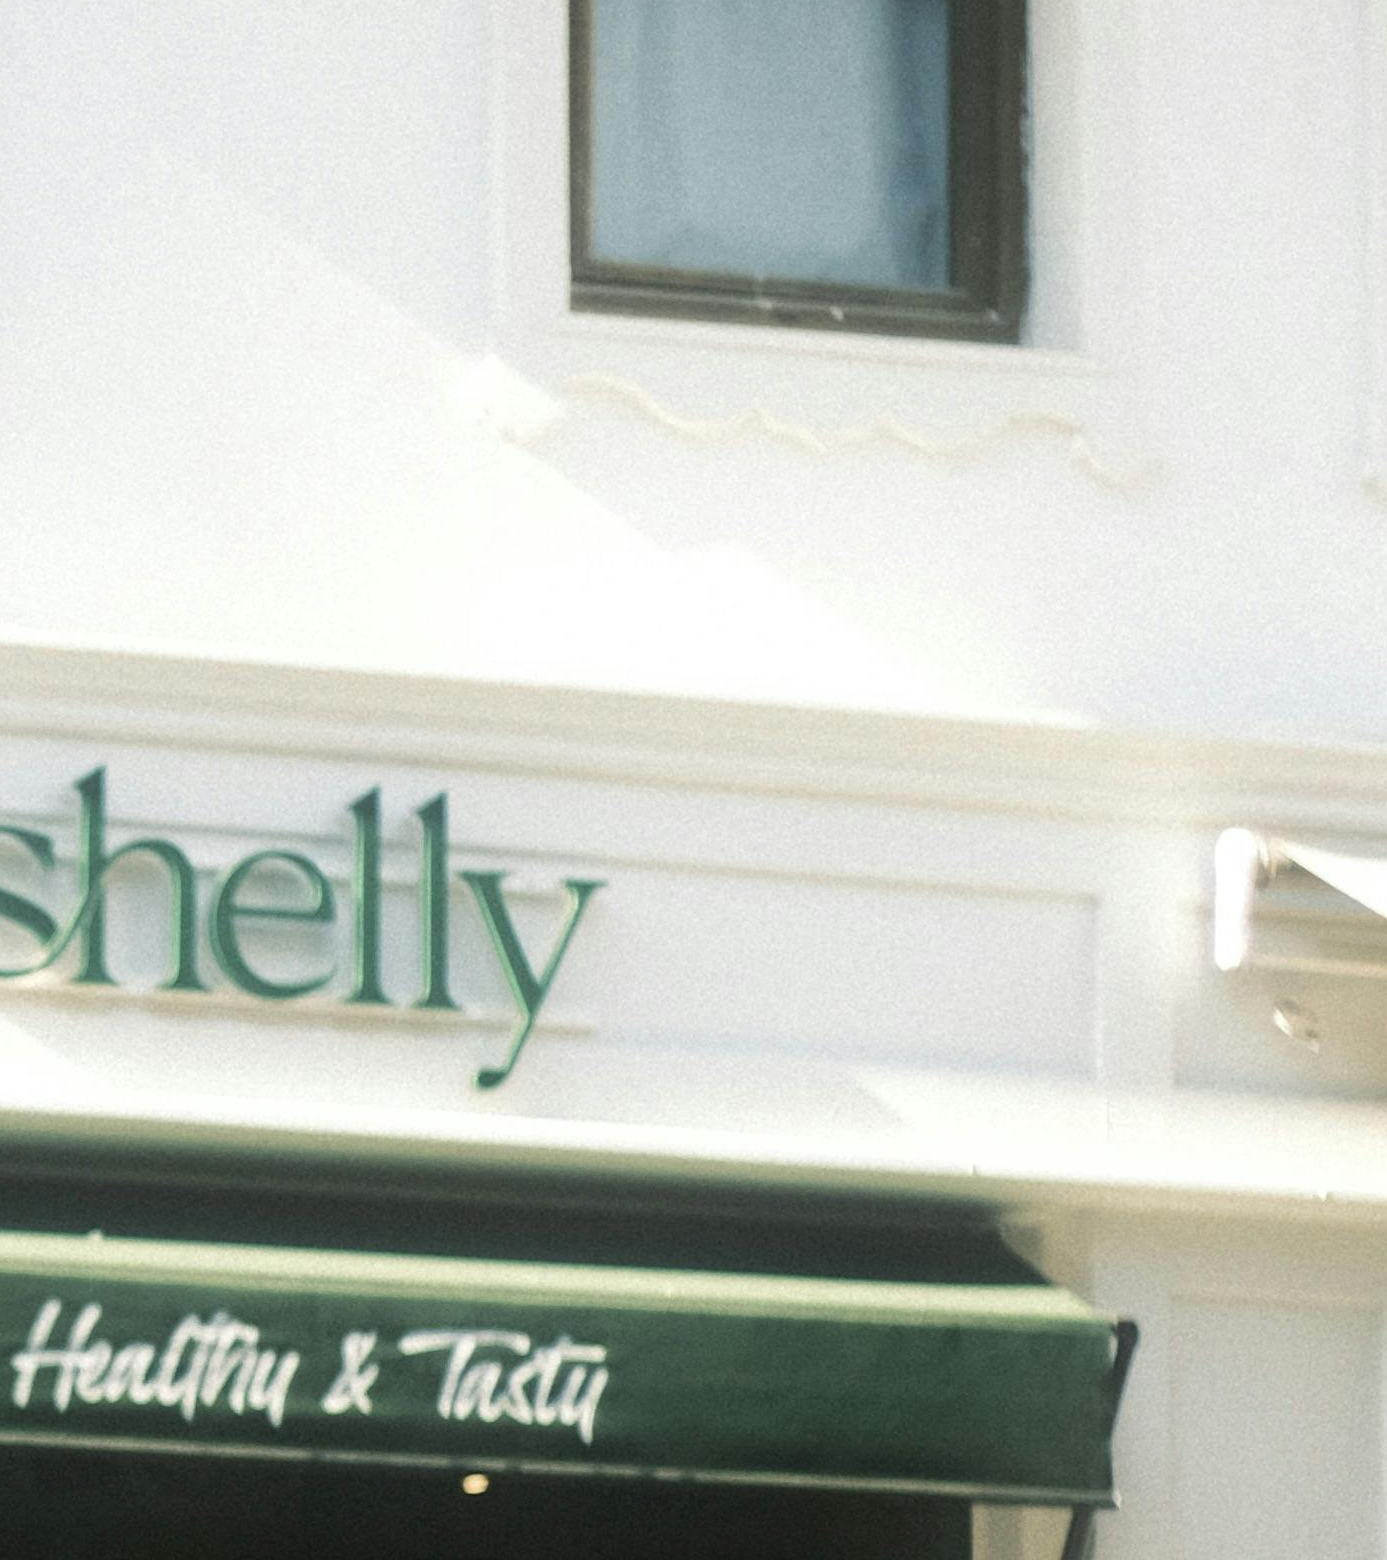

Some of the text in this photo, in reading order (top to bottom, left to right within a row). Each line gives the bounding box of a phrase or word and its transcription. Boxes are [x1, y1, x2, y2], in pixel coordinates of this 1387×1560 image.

[11, 1298, 610, 1445] Healthy & Tasty
